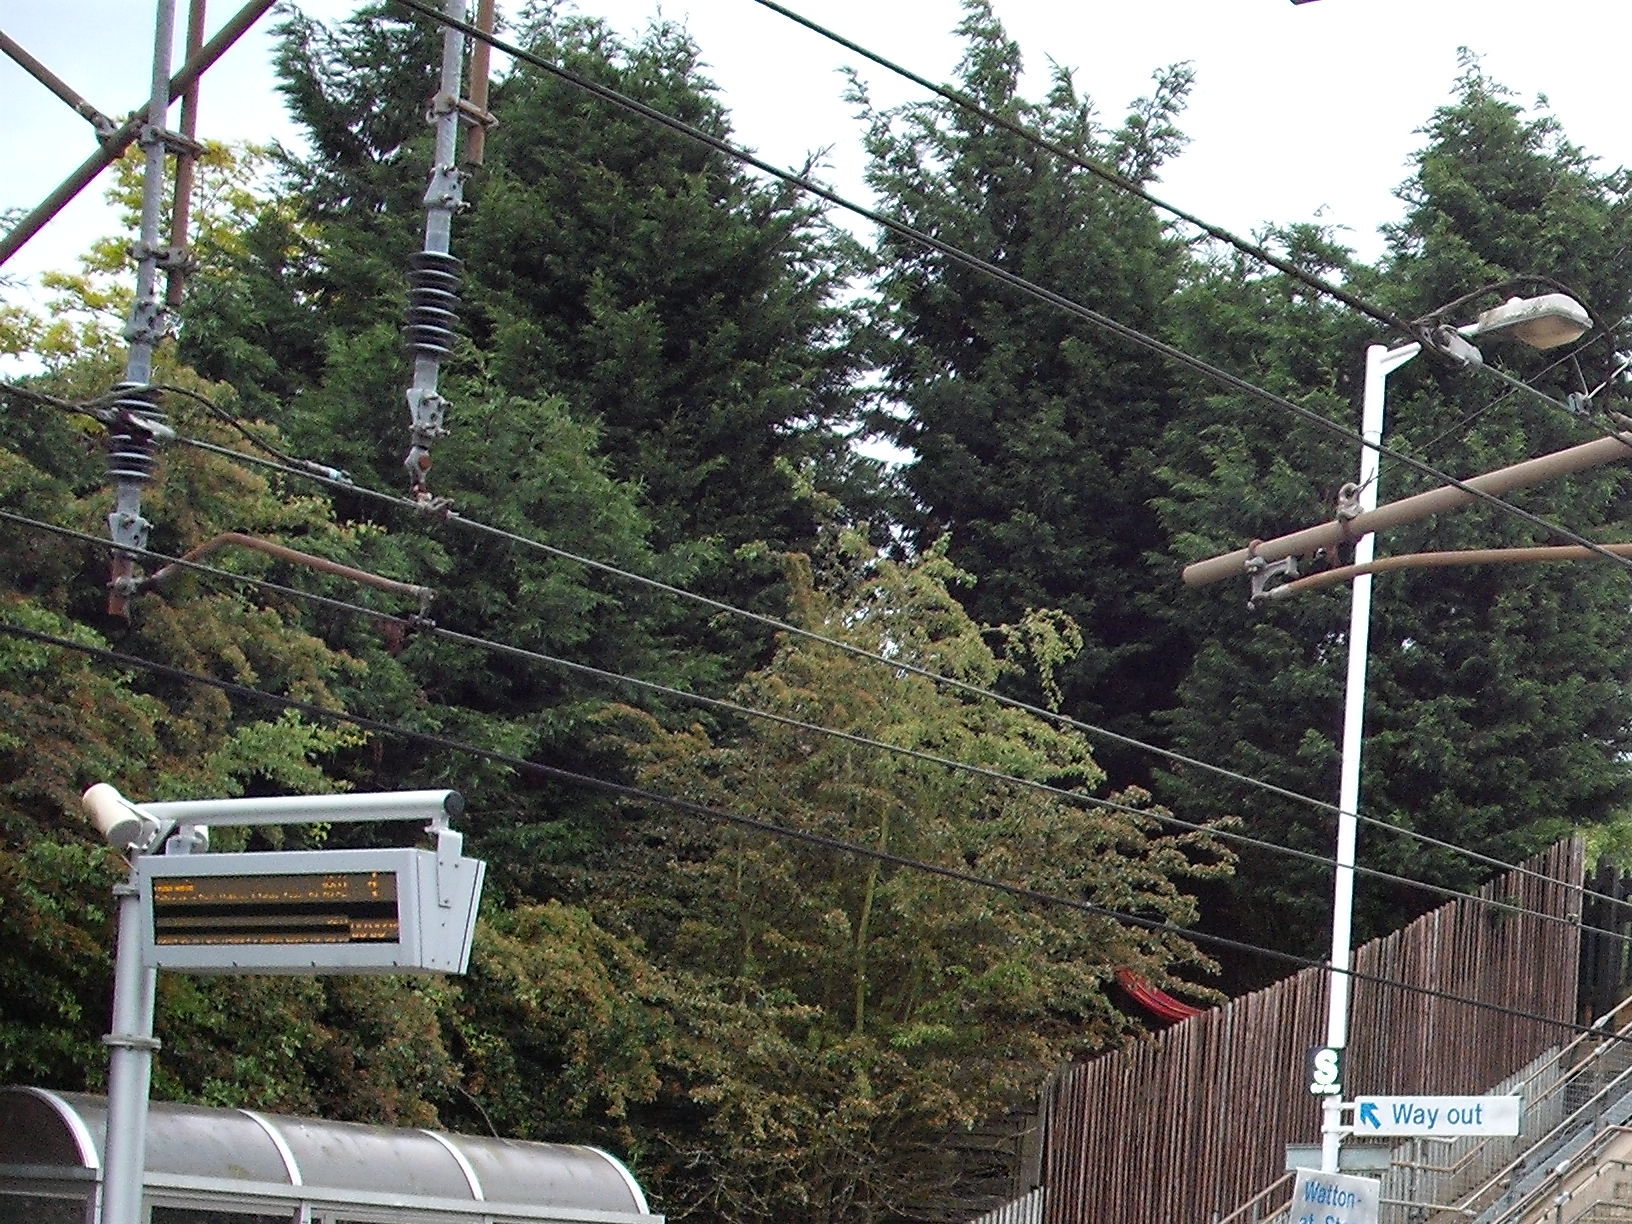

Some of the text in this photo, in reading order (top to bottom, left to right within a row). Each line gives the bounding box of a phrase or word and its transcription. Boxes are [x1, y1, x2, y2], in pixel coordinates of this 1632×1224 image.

[1313, 1048, 1338, 1085] S
[1393, 1103, 1482, 1128] Way out
[1304, 1180, 1362, 1209] Watton-
